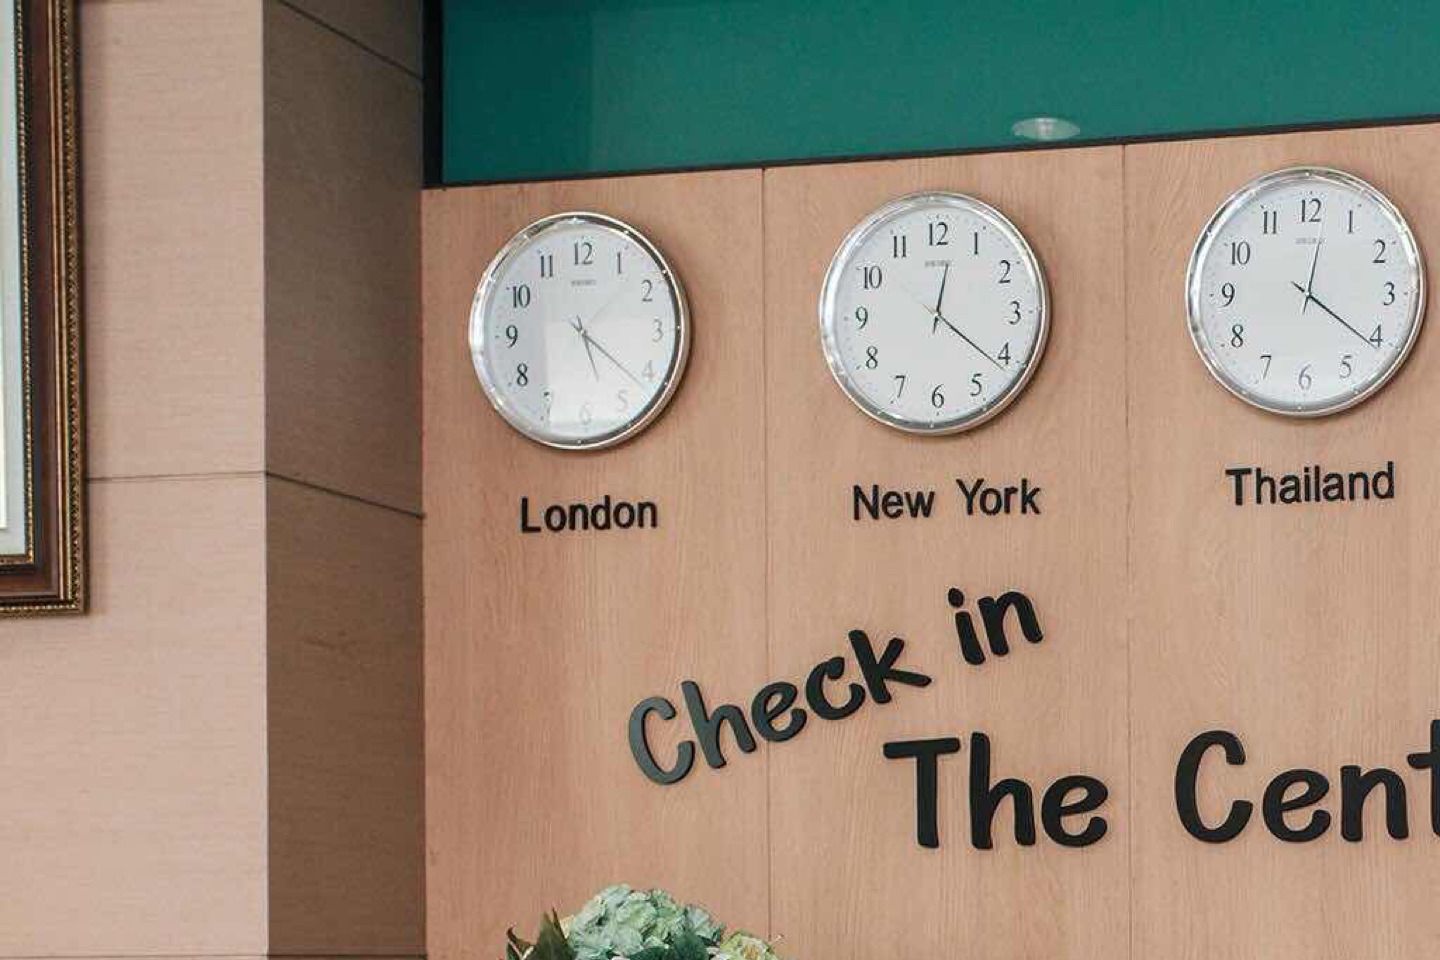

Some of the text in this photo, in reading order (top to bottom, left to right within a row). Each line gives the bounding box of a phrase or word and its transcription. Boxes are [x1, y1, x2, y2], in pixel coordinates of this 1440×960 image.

[1263, 210, 1277, 235] 11
[1300, 198, 1322, 223] 12
[1348, 210, 1354, 233] 1
[928, 222, 949, 246] 12
[973, 232, 979, 255] 1
[573, 242, 594, 266] 12
[893, 235, 907, 258] 11
[1231, 242, 1250, 266] 10
[1373, 239, 1386, 263] 2
[540, 255, 554, 278] 11
[616, 252, 622, 274] 1
[999, 260, 1011, 283] 2
[863, 265, 882, 289] 10
[512, 285, 531, 309] 10
[641, 279, 653, 302] 2
[1221, 283, 1235, 307] 9
[1383, 282, 1395, 306] 3
[855, 307, 868, 329] 9
[1009, 301, 1021, 325] 3
[506, 325, 518, 348] 9
[652, 319, 663, 342] 3
[1231, 324, 1244, 348] 8
[1369, 324, 1382, 347] 4
[866, 346, 878, 370] 8
[998, 342, 1011, 365] 4
[517, 363, 528, 386] 8
[1260, 355, 1272, 380] 7
[1298, 364, 1311, 390] 6
[1339, 356, 1352, 378] 5
[895, 375, 906, 398] 7
[931, 384, 944, 408] 6
[970, 373, 982, 396] 5
[1224, 460, 1396, 507] Thailand
[852, 477, 1042, 522] New York
[519, 494, 660, 535] London
[628, 587, 1045, 786] Check in
[882, 731, 1109, 851] The
